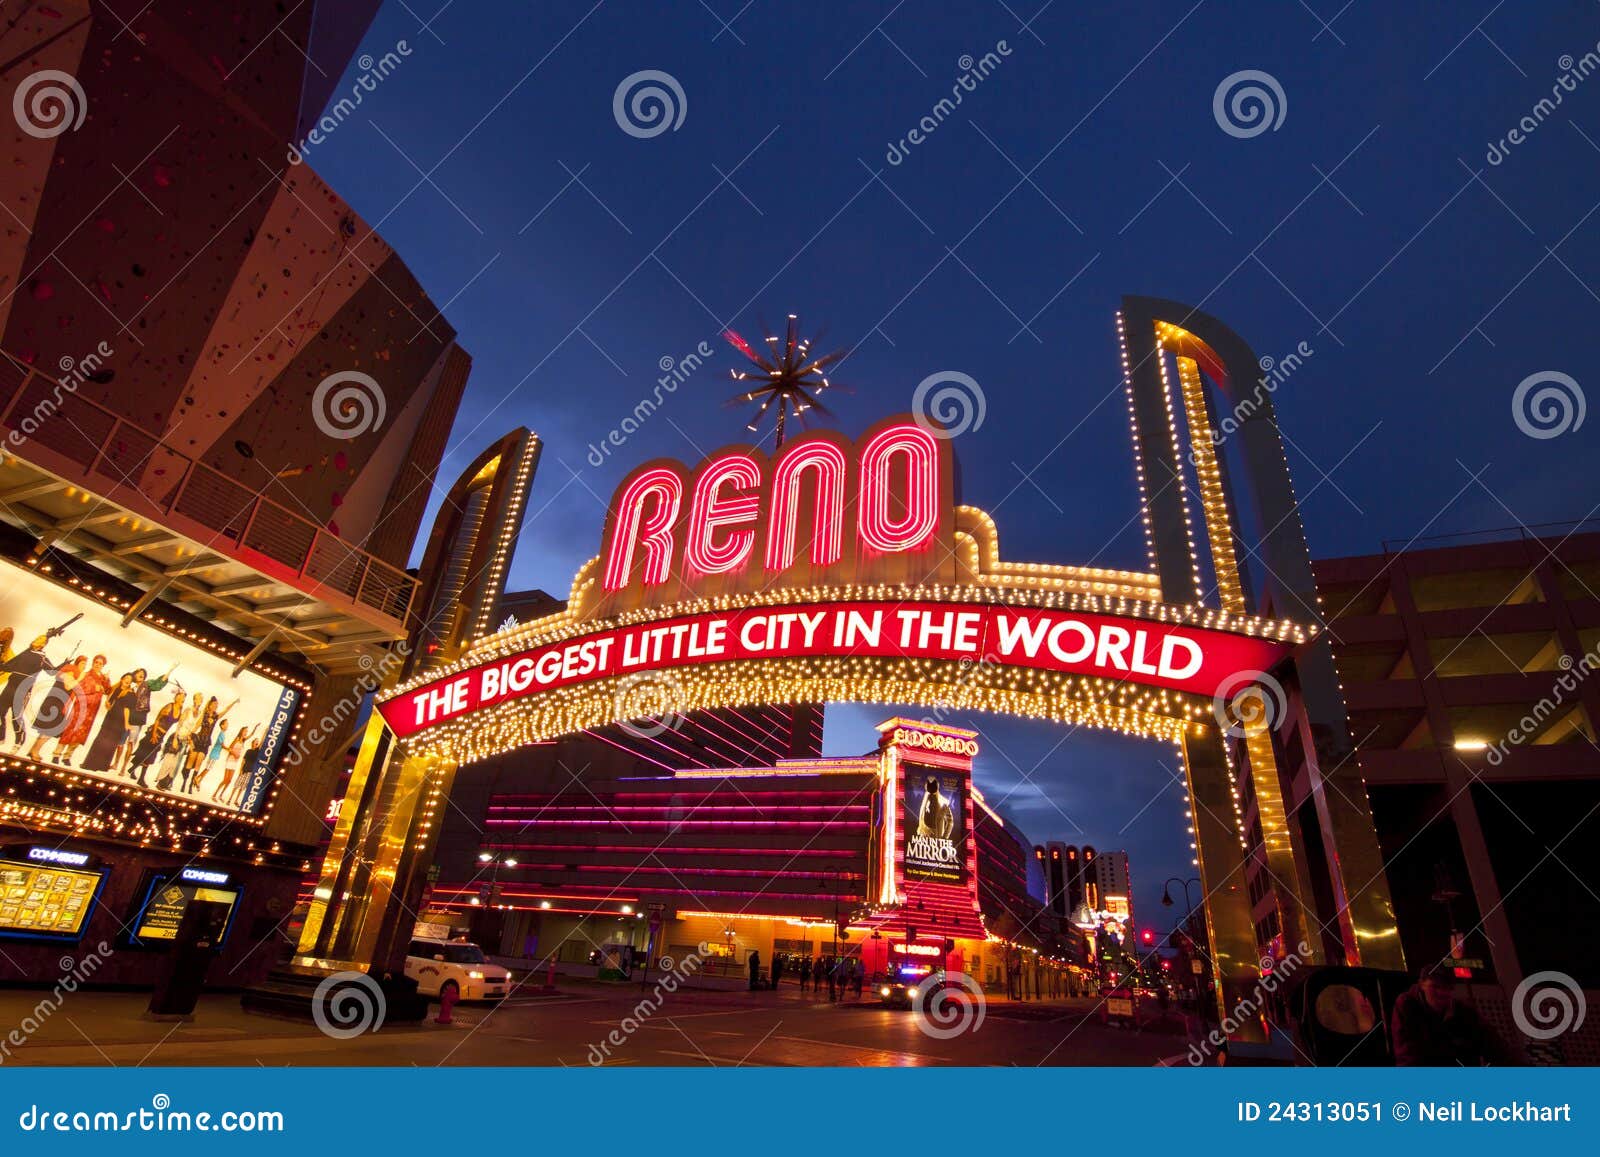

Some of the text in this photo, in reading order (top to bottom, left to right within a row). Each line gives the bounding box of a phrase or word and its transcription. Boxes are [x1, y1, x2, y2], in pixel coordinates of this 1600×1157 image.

[604, 425, 939, 592] RENO
[413, 610, 1204, 726] THE BIGGEST LITTLE CITY IN THE WORLD
[241, 689, 295, 814] Reno's Looking Up
[906, 841, 960, 864] MIRROR
[911, 834, 953, 849] MAN IN THE
